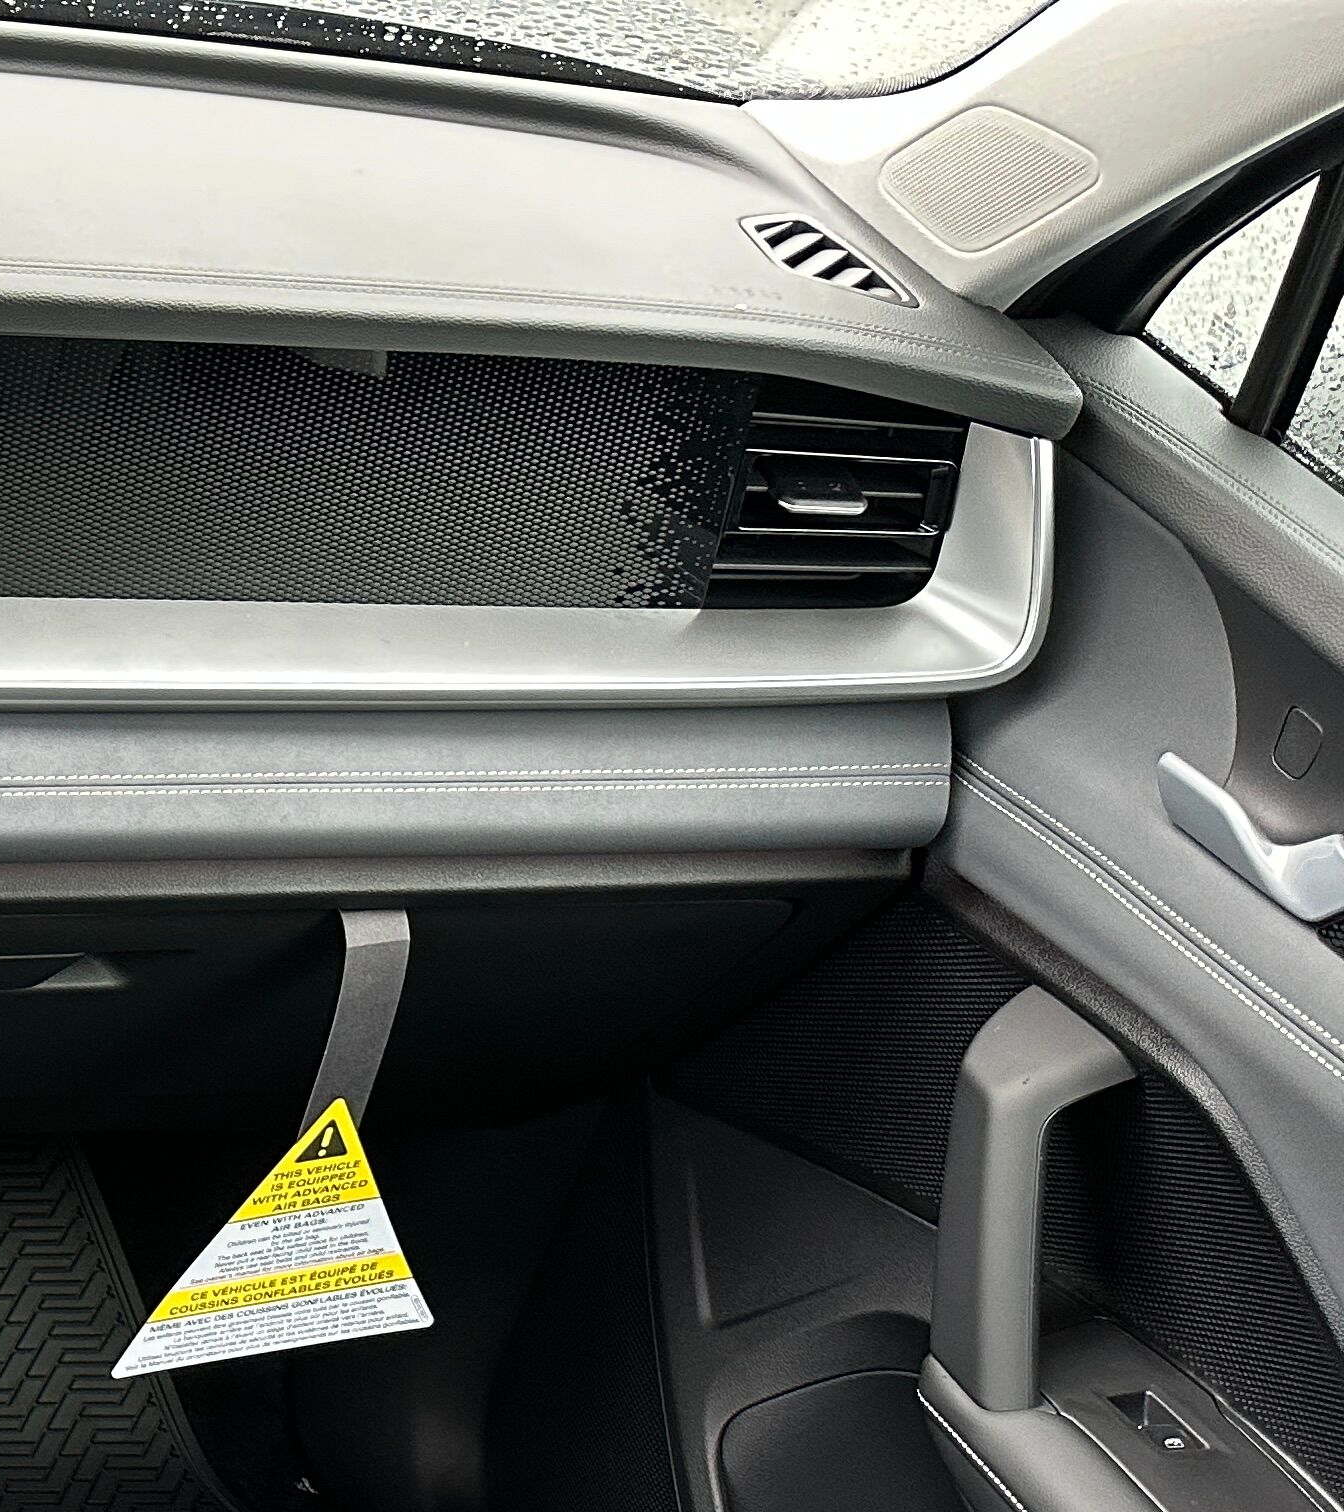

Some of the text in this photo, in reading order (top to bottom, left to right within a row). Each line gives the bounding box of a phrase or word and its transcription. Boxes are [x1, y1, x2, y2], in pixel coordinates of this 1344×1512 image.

[270, 1169, 356, 1192] IS EQUIPPED
[273, 1159, 360, 1181] THIS VEHICLE
[252, 1178, 368, 1205] WITH ADVANCED
[272, 1193, 340, 1212] AIR BAGS
[240, 1202, 365, 1230] EVEN WITH ADVANCED
[271, 1217, 328, 1232] AIR BAGS:
[170, 1268, 394, 1315] COUSSINS GONFLABLES ÉVOLUÉS
[191, 1260, 378, 1301] CE VÉHICULE EST ÉQUIPÉ DE
